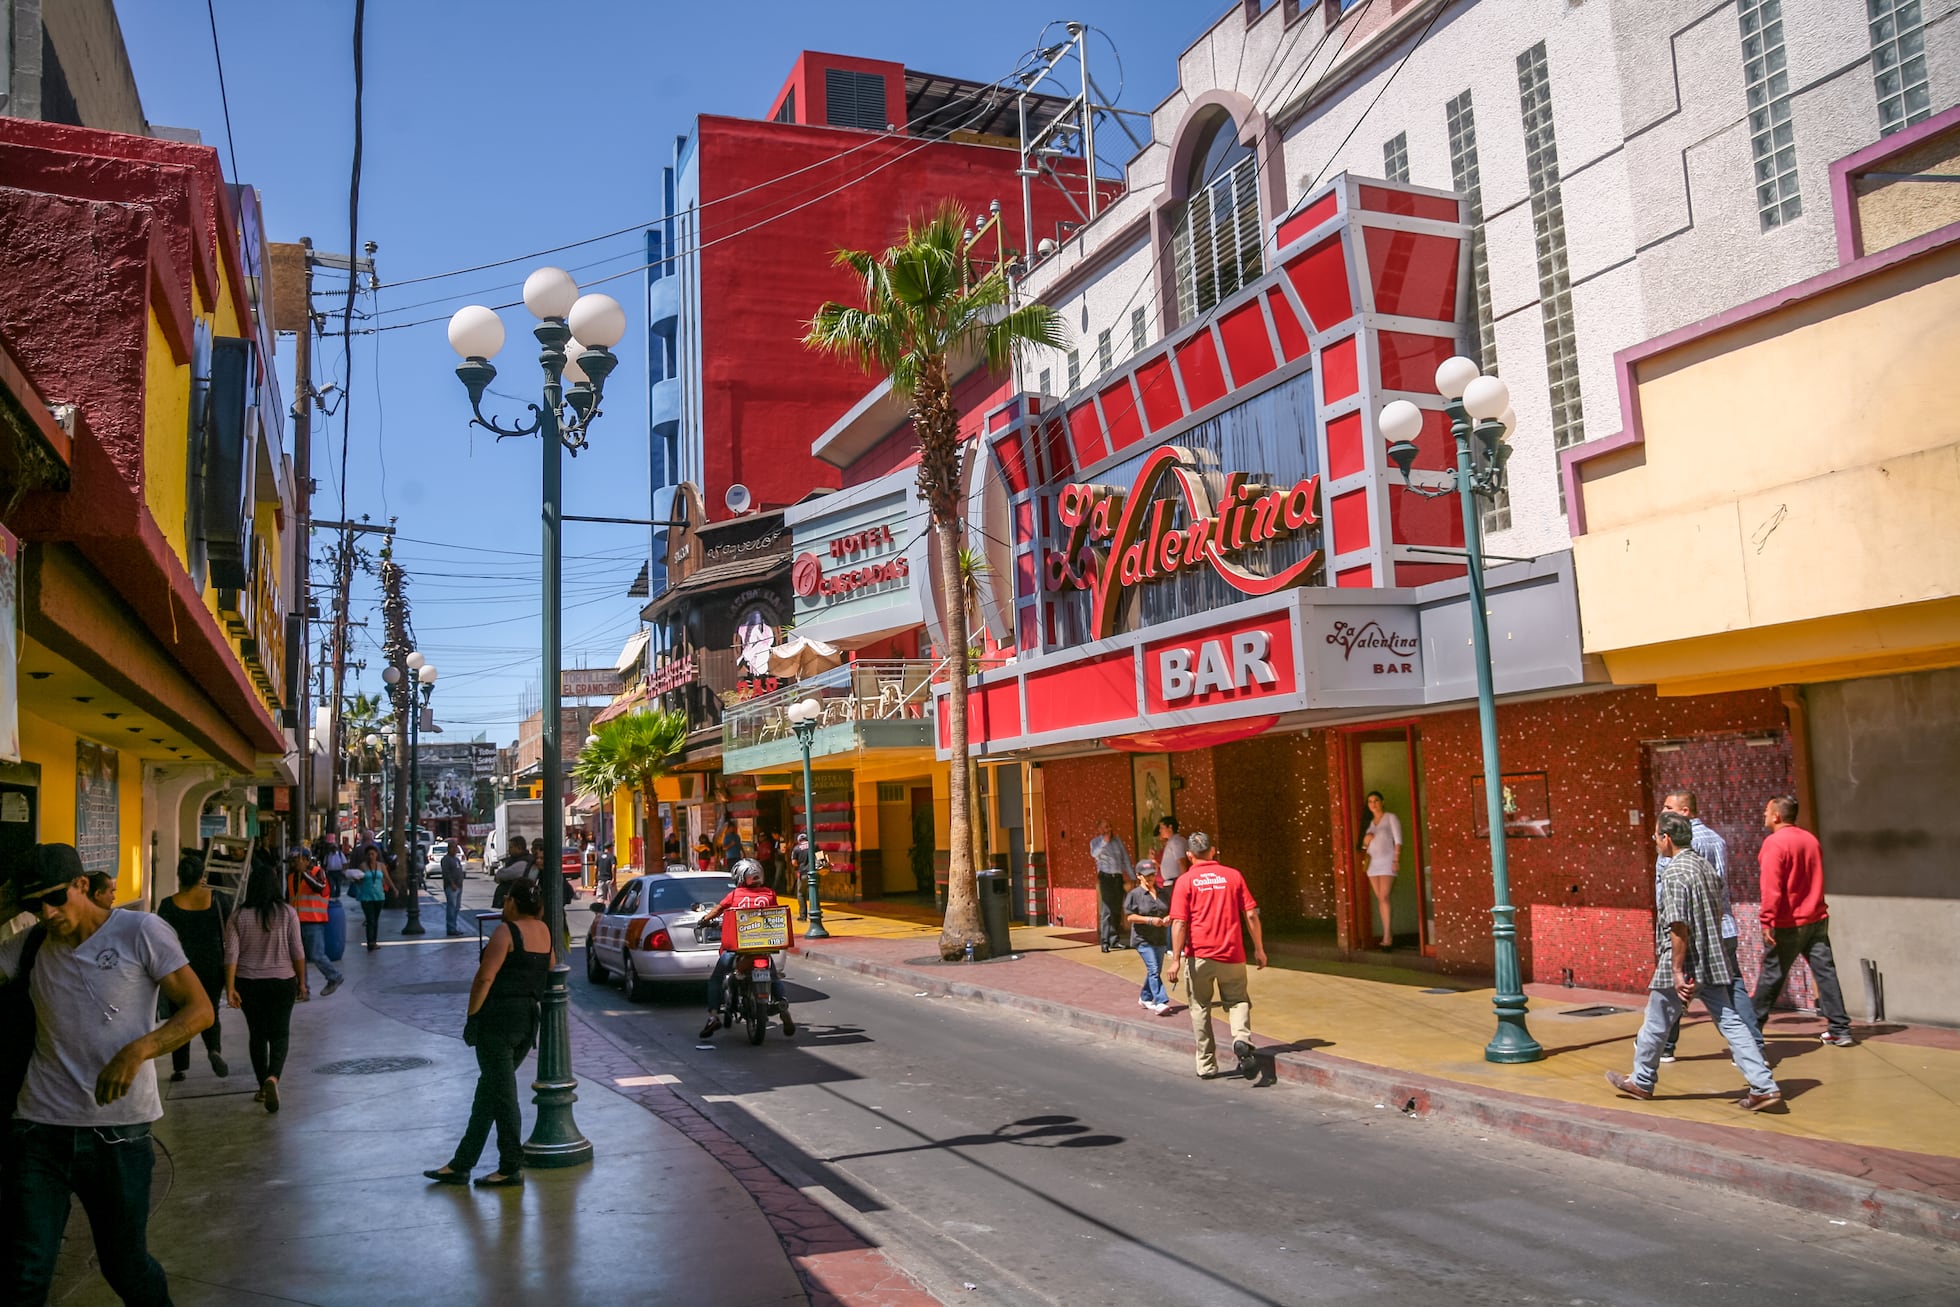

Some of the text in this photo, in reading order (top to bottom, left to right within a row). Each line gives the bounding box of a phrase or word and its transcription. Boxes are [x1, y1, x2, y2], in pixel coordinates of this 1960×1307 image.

[829, 524, 895, 558] HOTEL
[1045, 445, 1322, 642] La Valentina
[818, 557, 910, 597] CASCADAS
[1326, 620, 1418, 662] La Valentina
[1160, 630, 1280, 702] BAR
[1373, 663, 1412, 674] BAR
[563, 684, 574, 695] EL
[738, 921, 761, 932] Gratis
